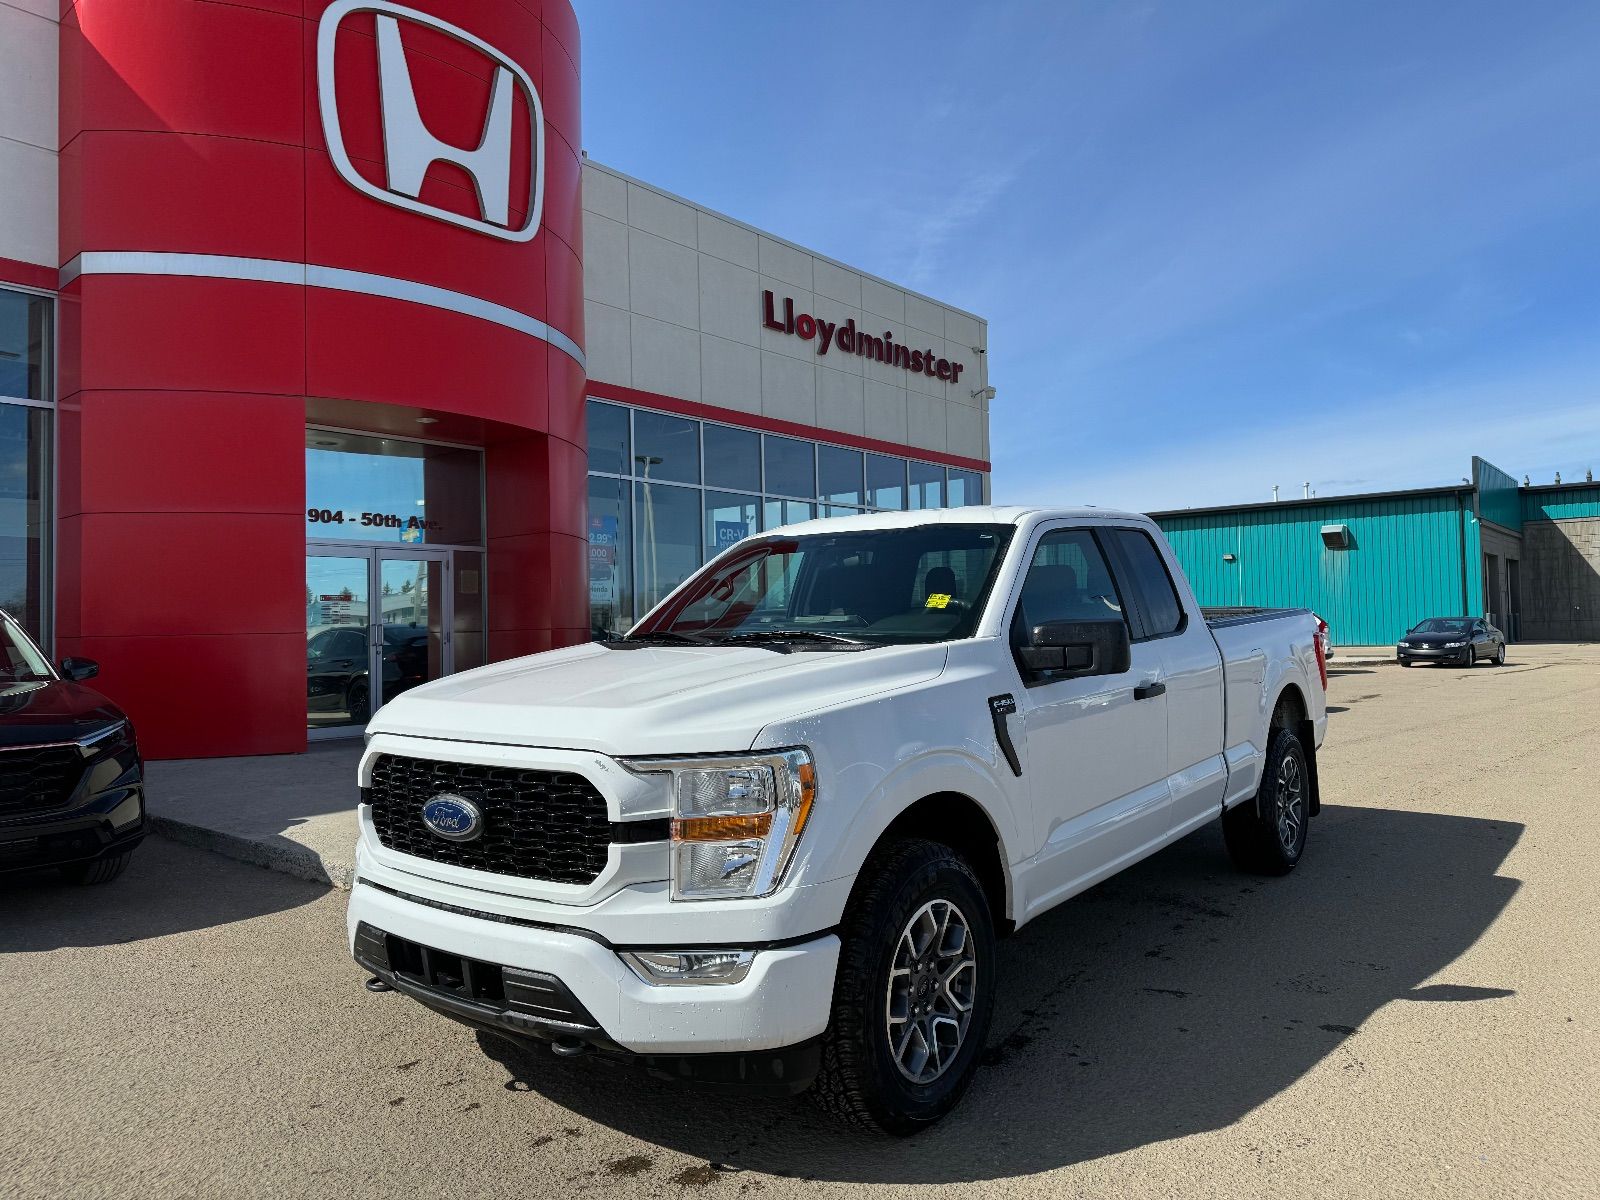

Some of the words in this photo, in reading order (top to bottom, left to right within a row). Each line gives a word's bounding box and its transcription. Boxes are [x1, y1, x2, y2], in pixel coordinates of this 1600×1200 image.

[762, 289, 963, 384] Lloydminster
[307, 508, 344, 525] 904
[361, 512, 402, 529] 50th
[719, 528, 745, 541] CR-V
[432, 806, 463, 829] Ford
